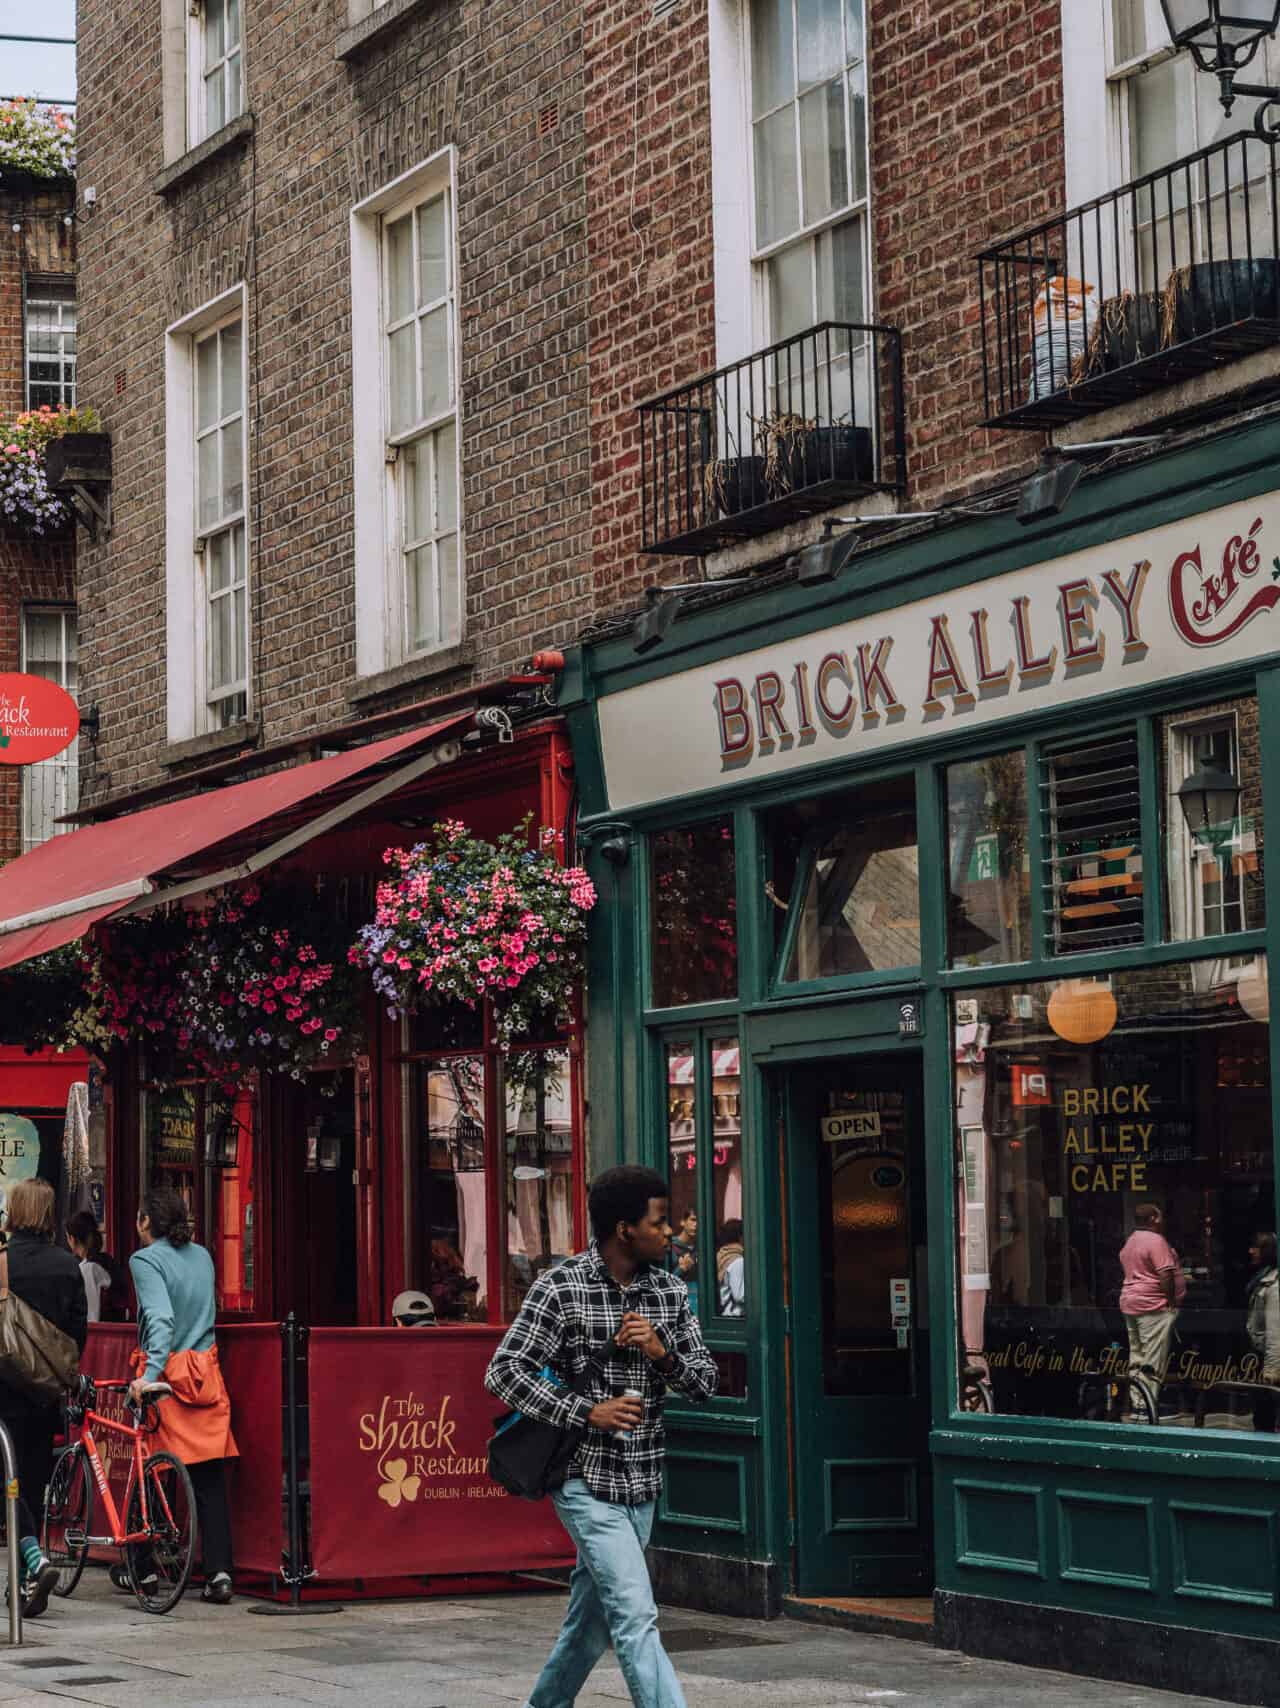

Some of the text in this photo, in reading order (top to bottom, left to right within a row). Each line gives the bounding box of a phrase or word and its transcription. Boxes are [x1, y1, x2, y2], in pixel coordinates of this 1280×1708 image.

[713, 634, 907, 774] BRICK
[921, 558, 1153, 724] ALLEY
[6, 724, 69, 738] Restaurant
[1063, 1084, 1152, 1118] BRICK
[827, 1116, 877, 1136] OPEN
[1062, 1123, 1153, 1155] ALLEY
[1071, 1154, 1148, 1192] CAFÉ
[983, 1343, 1012, 1367] ocal
[1048, 1351, 1064, 1371] in
[1070, 1343, 1092, 1373] the
[1178, 1350, 1239, 1390] Temple
[392, 1391, 425, 1419] The
[359, 1394, 457, 1466] Shack
[424, 1487, 460, 1499] DUBLIN
